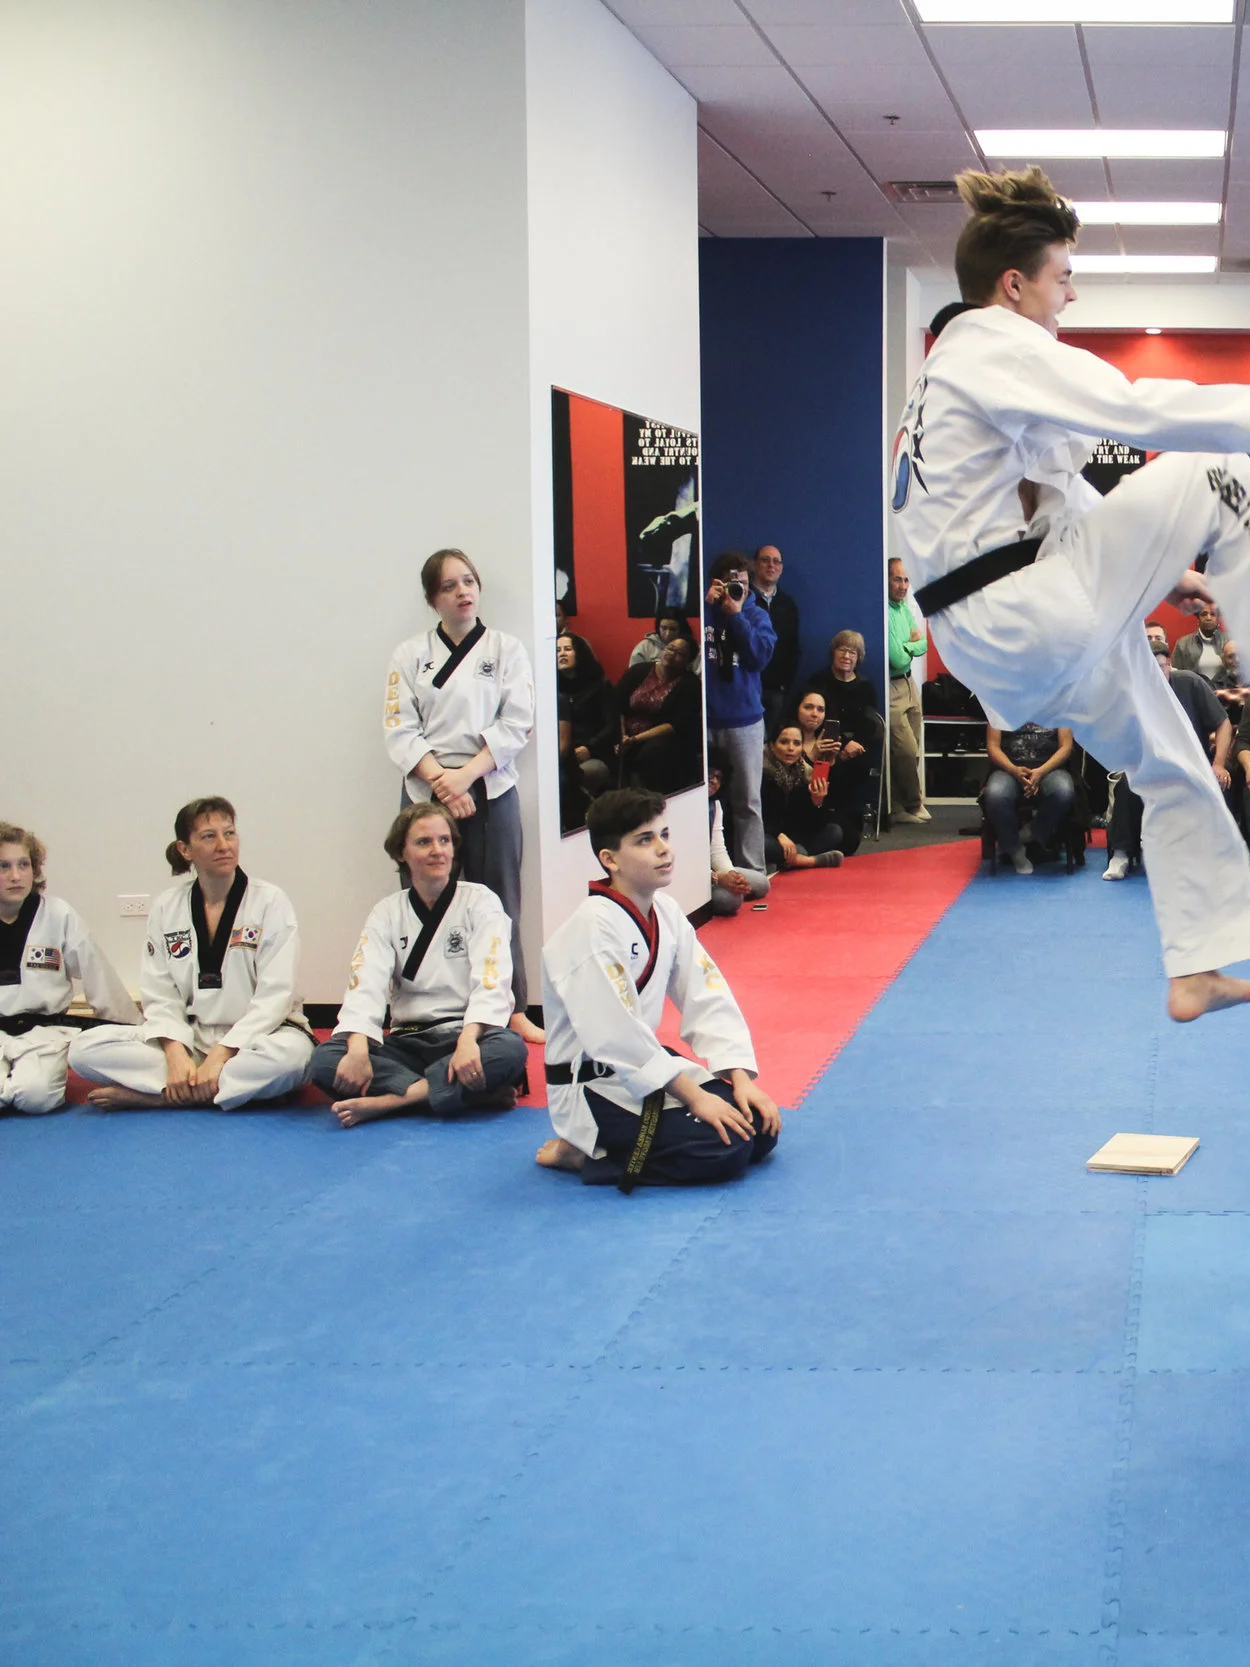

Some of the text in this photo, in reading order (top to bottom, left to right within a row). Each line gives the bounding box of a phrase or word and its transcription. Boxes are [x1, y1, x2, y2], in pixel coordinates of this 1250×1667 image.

[1113, 445, 1130, 455] AND
[1097, 455, 1114, 464] THE
[1117, 455, 1140, 464] WEAK
[385, 671, 401, 728] DEMO
